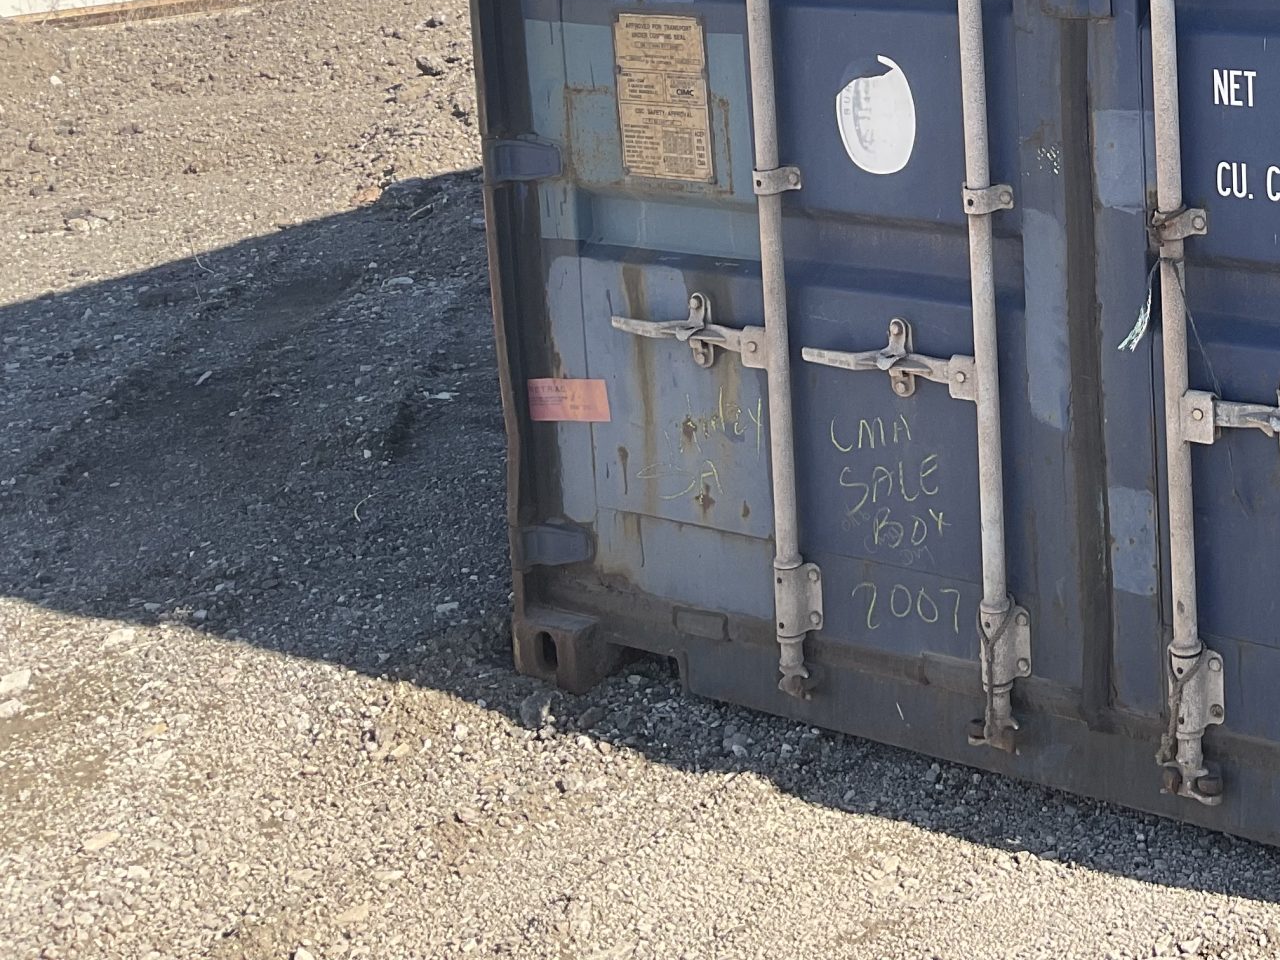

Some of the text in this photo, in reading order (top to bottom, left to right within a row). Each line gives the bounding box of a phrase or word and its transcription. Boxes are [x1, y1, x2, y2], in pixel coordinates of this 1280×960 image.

[1213, 68, 1258, 108] NET
[1216, 161, 1254, 202] CU.
[839, 453, 940, 515] SALE
[851, 582, 961, 635] 2007
